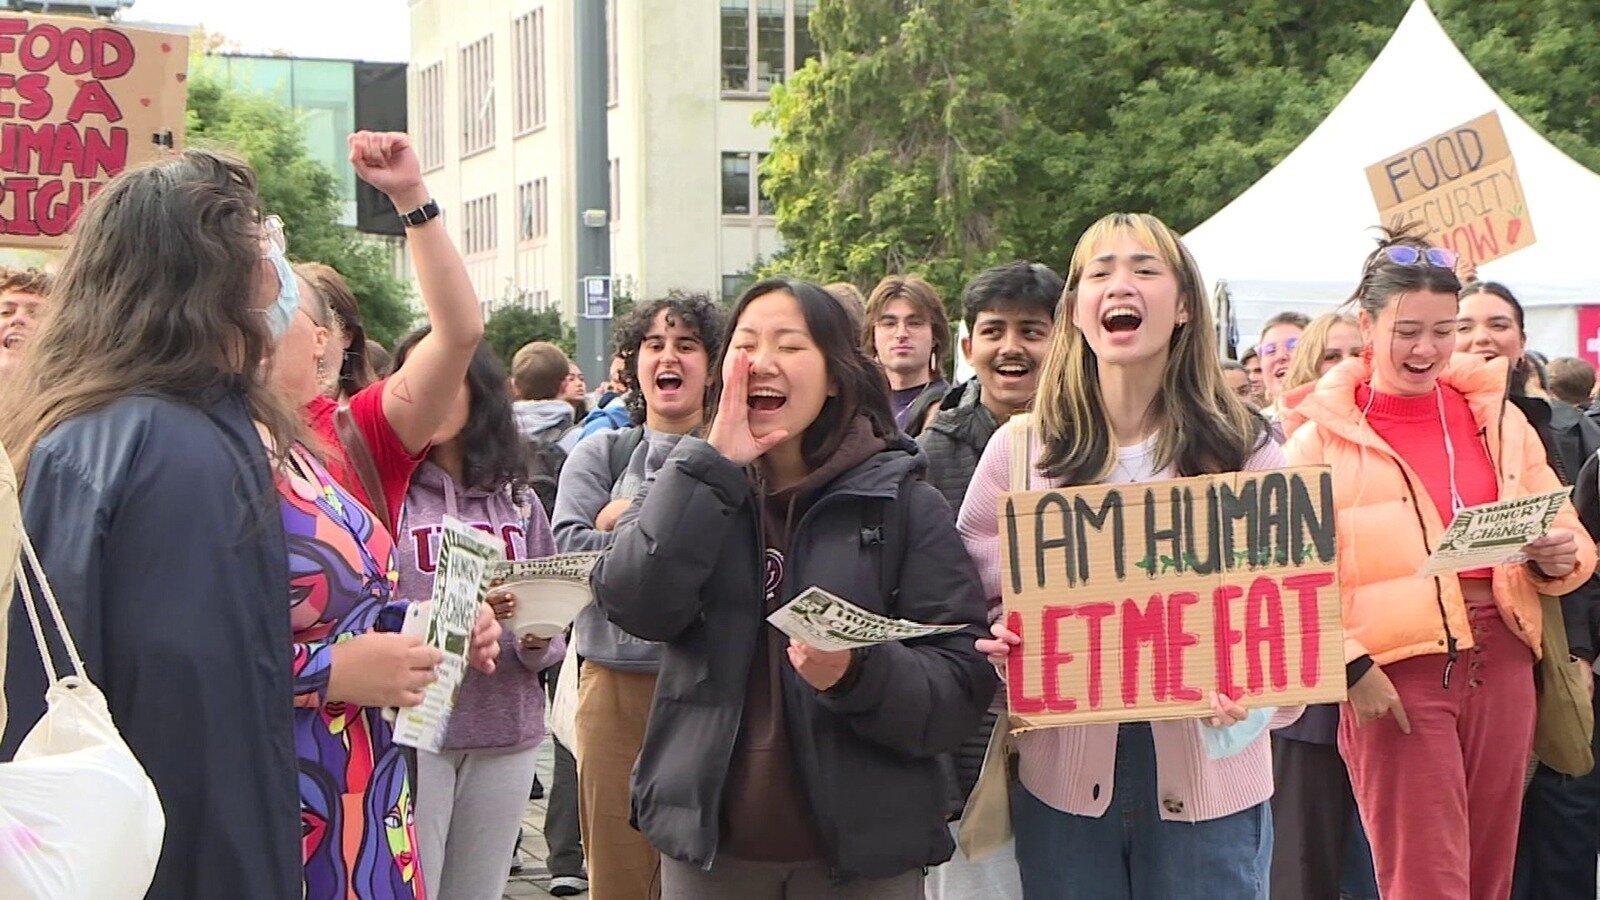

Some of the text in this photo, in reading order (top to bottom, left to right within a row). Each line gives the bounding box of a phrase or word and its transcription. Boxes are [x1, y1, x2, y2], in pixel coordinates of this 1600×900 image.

[67, 80, 123, 123] A
[1385, 128, 1483, 203] FOOD
[409, 522, 526, 575] UC
[1005, 472, 1336, 594] I AM HUMAN
[1470, 520, 1534, 540] CHANGE
[1007, 572, 1337, 713] LET ME EAT
